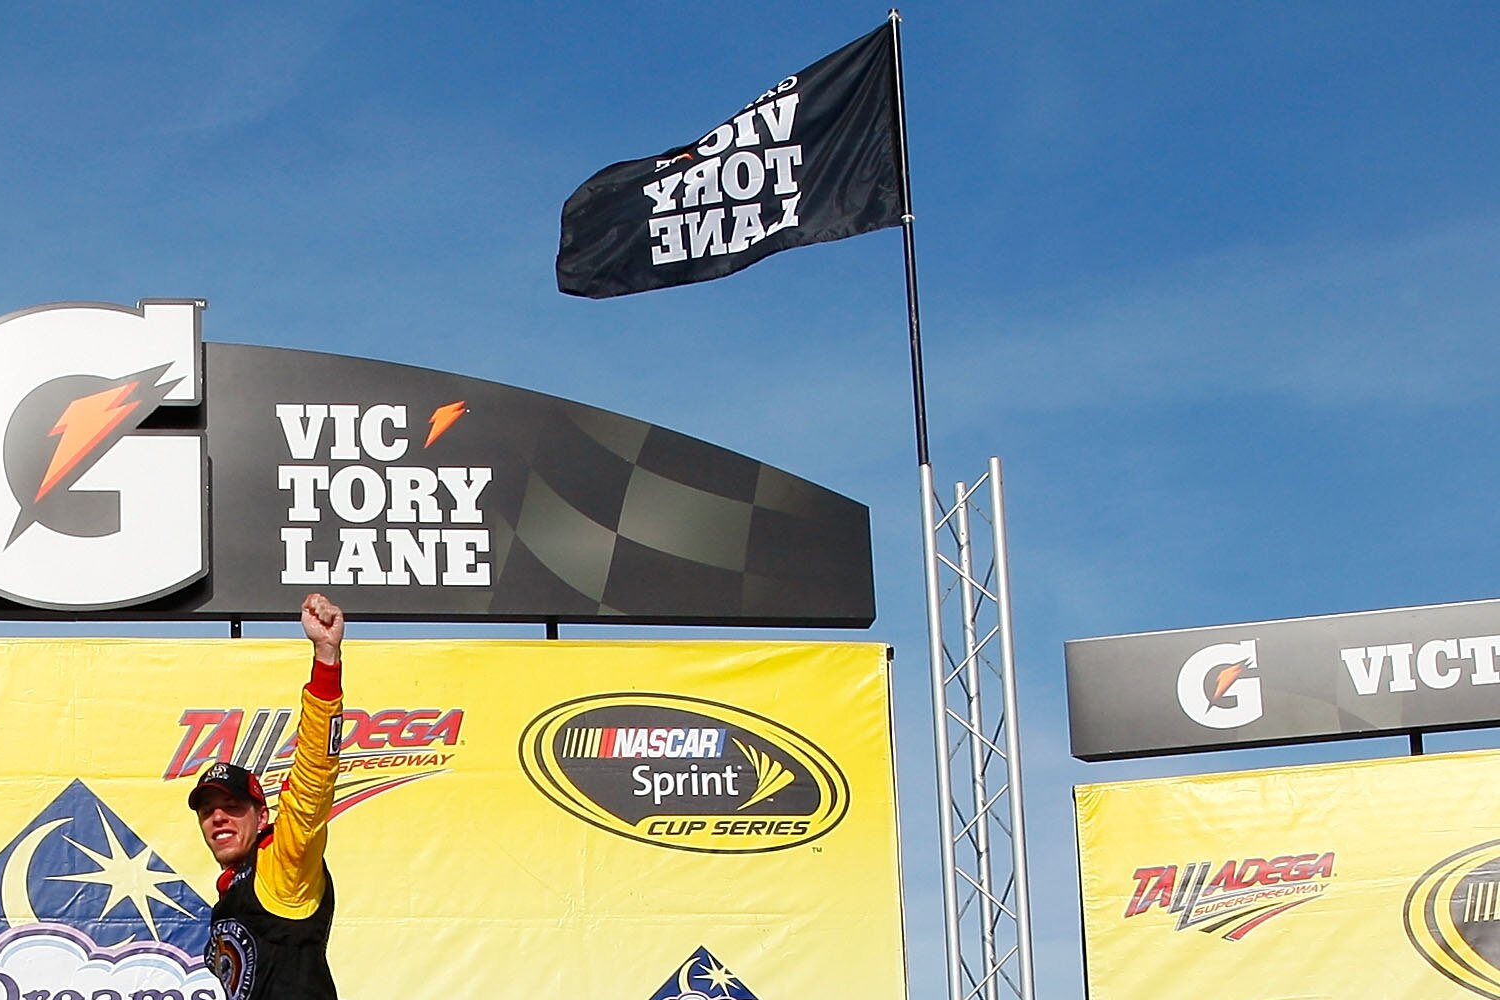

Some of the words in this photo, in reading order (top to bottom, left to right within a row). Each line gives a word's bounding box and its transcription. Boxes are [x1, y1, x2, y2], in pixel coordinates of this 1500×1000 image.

[275, 403, 410, 462] VIC
[276, 465, 493, 525] TORY
[279, 527, 492, 587] LANE
[163, 708, 465, 783] TALLDEGA
[613, 727, 720, 759] NASCAR
[632, 763, 741, 805] Sprint
[647, 821, 707, 836] CUP
[711, 820, 811, 836] SERIES
[1123, 851, 1336, 922] TALLADEGA
[1193, 882, 1331, 918] SUPERSPEEDWAY
